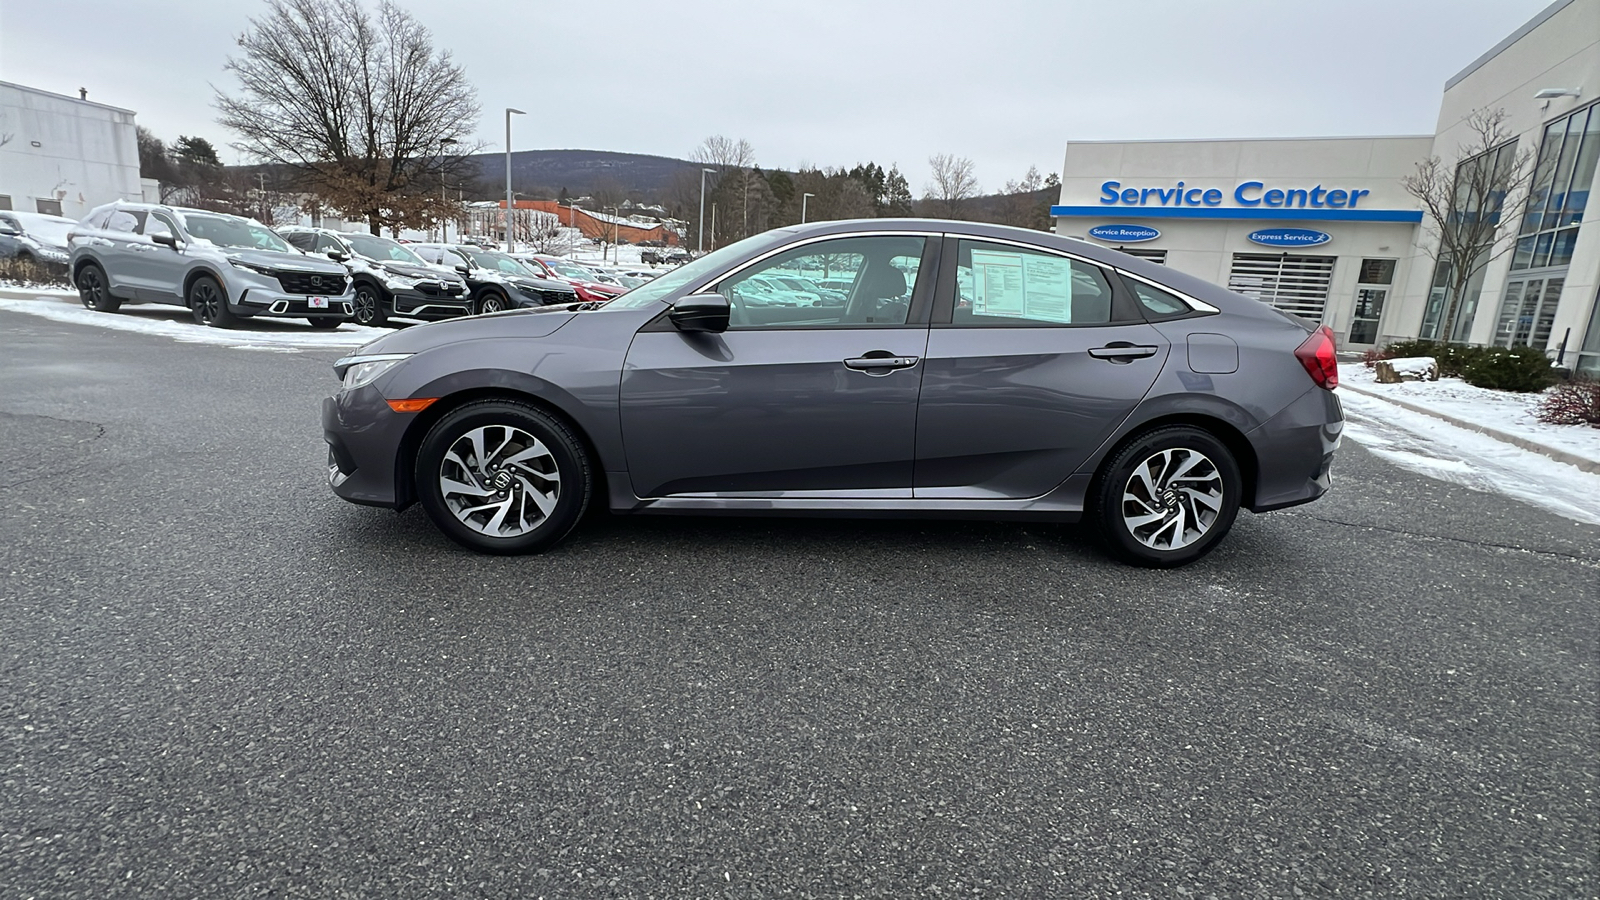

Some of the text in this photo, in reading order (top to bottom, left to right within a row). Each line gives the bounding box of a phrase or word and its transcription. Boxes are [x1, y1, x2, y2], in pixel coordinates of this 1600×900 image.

[1099, 181, 1371, 209] Service Center
[1093, 228, 1156, 238] Service Reception
[1251, 233, 1314, 242] Express Service
